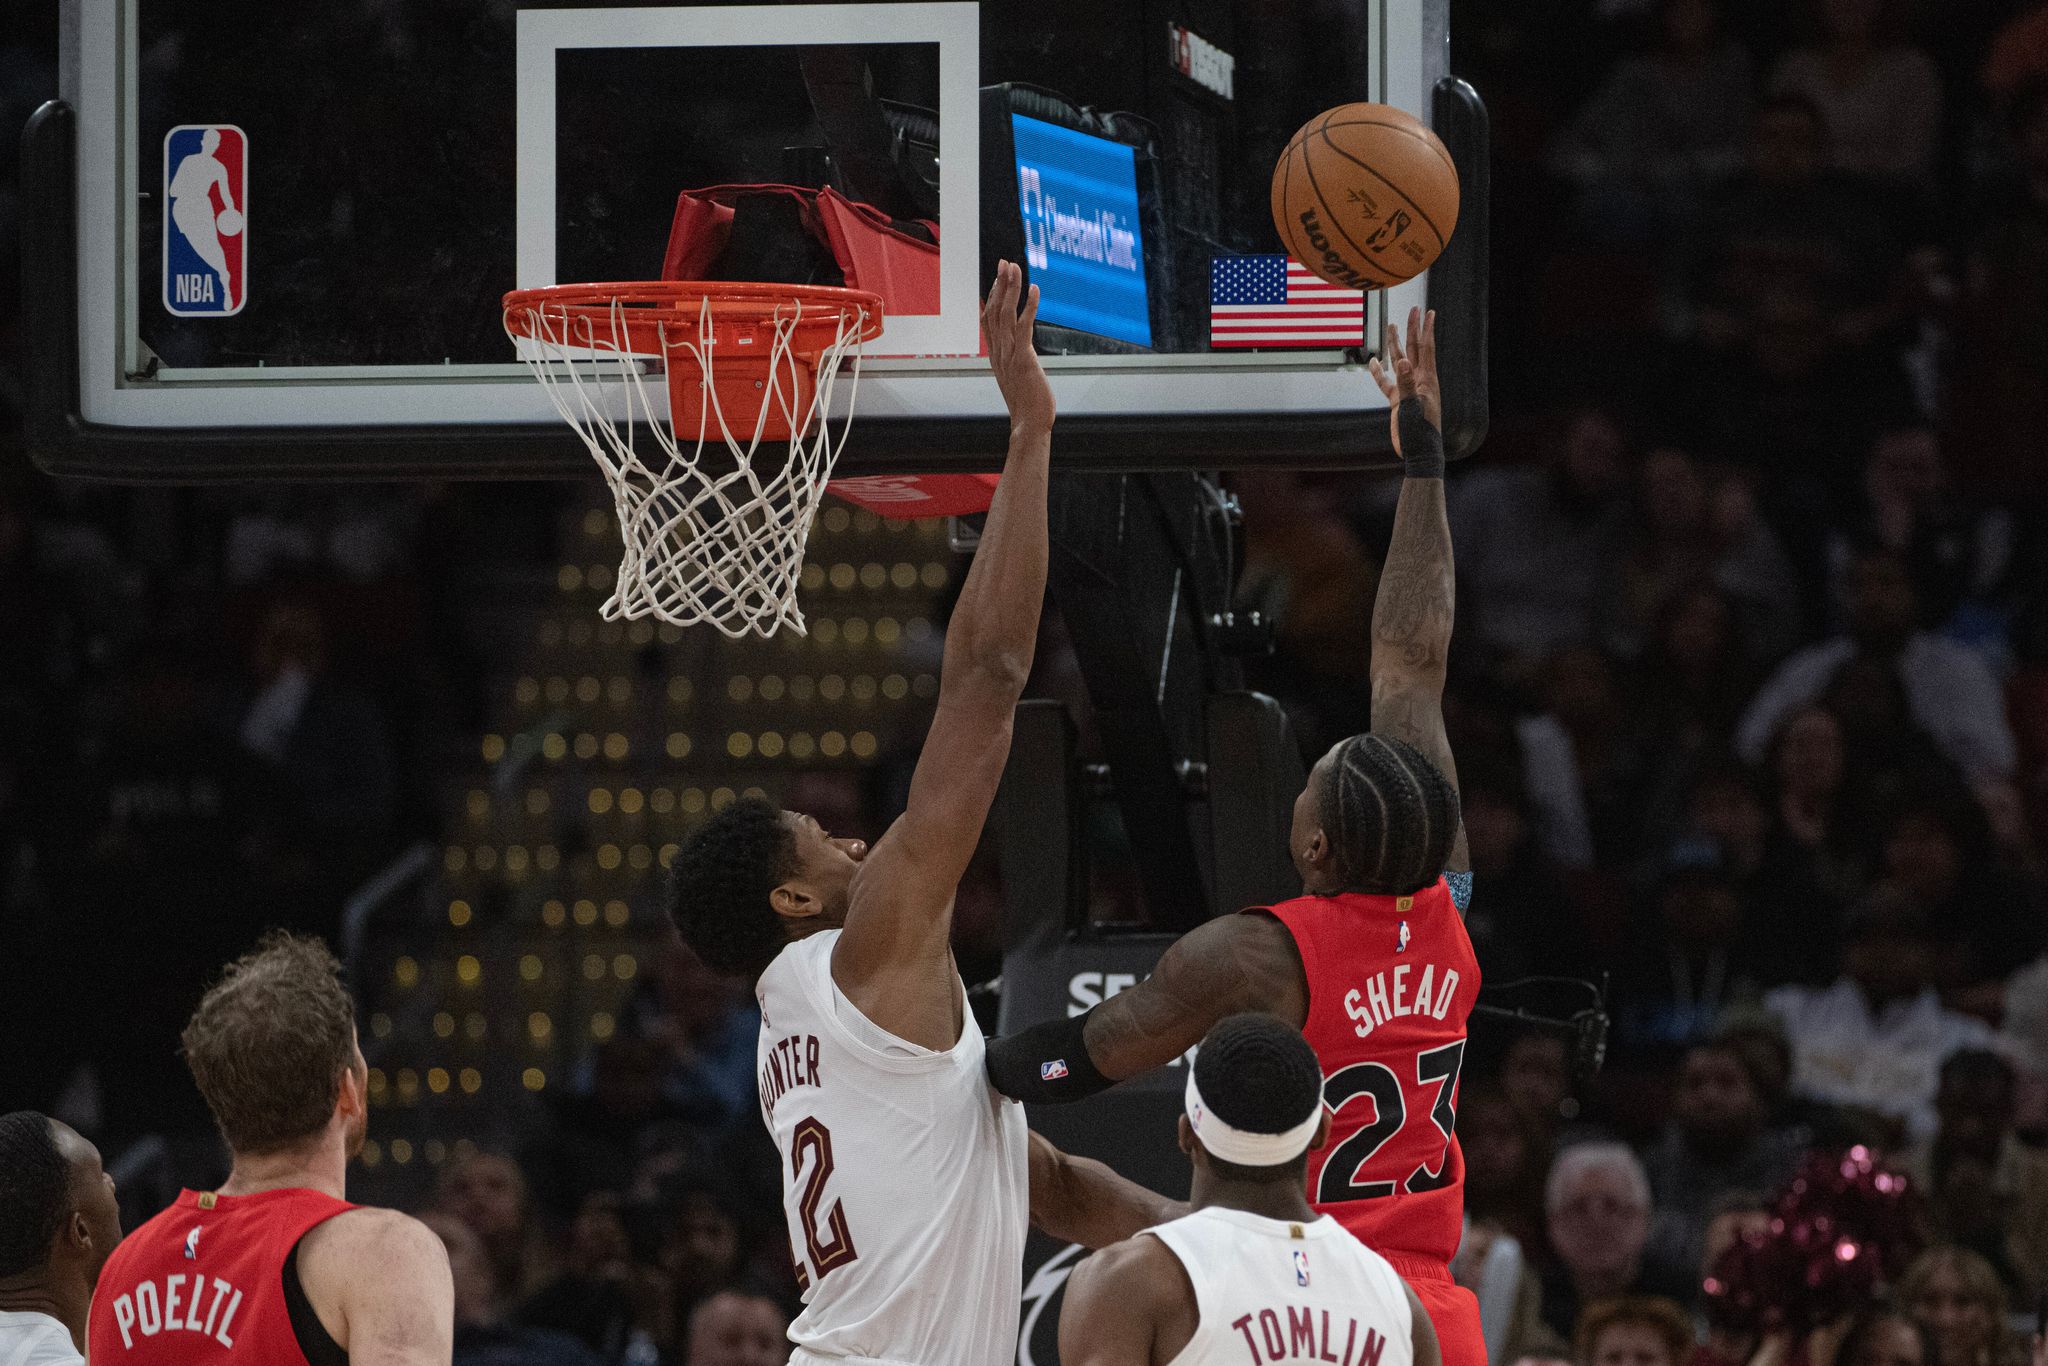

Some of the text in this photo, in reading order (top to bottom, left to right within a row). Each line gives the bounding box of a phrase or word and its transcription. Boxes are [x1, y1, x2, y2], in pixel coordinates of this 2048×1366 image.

[176, 274, 214, 303] NBA
[1344, 964, 1460, 1038] SHEAD
[1318, 1039, 1466, 1203] 23
[113, 1274, 243, 1350] POELTL
[1231, 1305, 1387, 1366] TOMLIN
